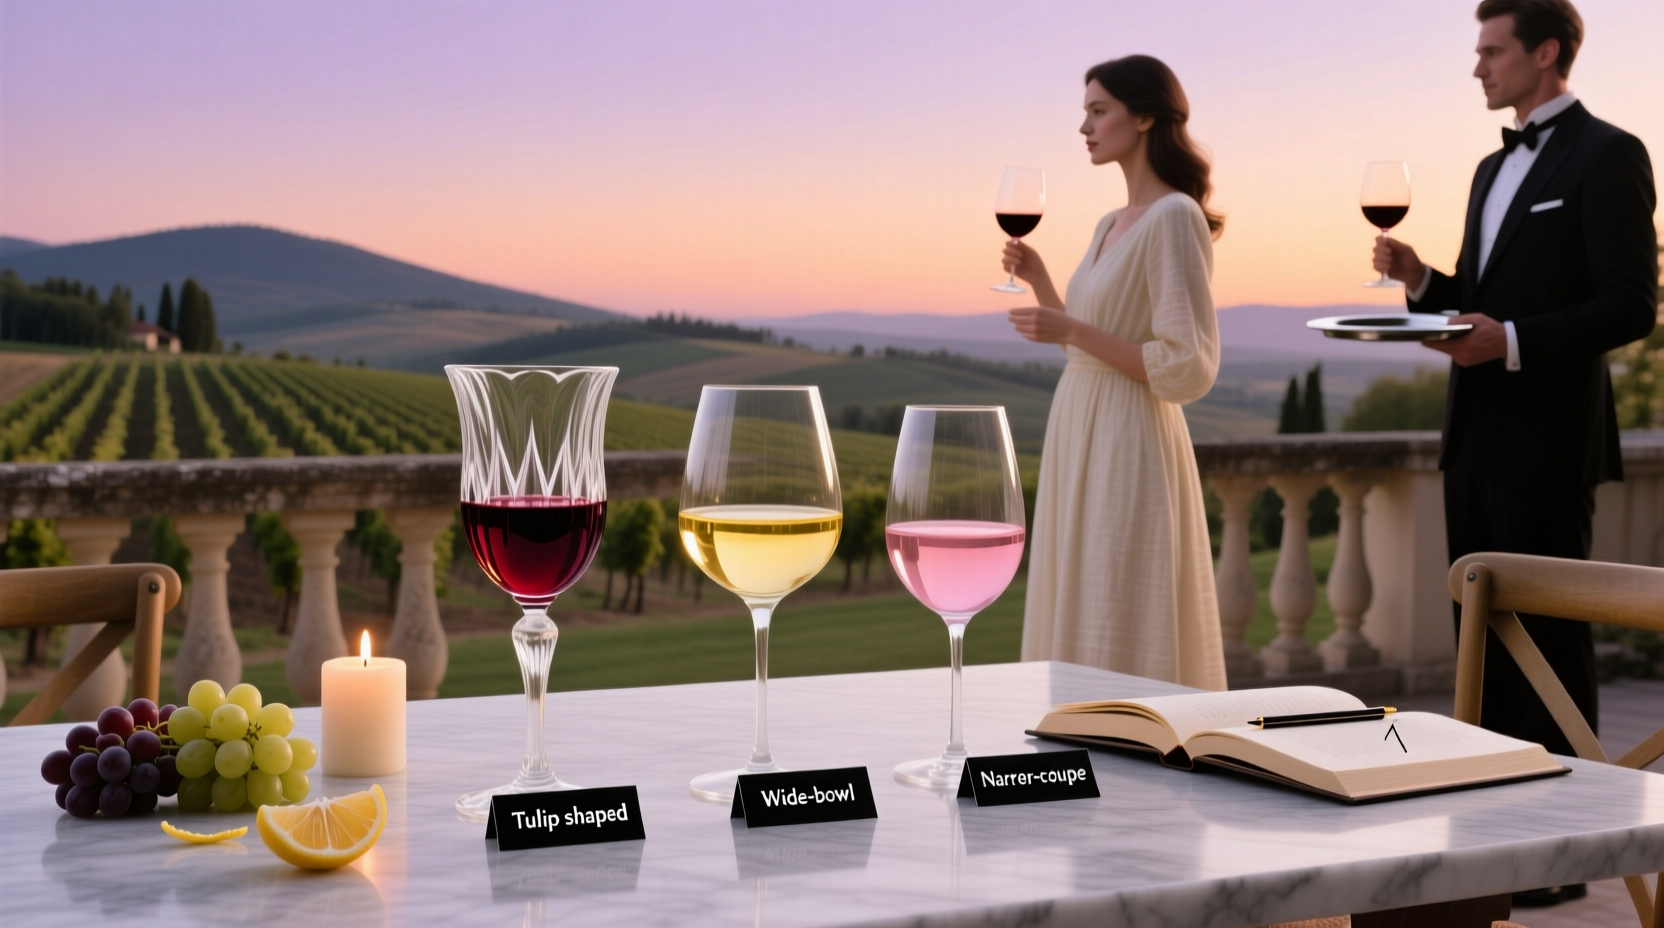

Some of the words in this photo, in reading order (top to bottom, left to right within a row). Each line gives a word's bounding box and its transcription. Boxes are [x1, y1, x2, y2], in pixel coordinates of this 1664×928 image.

[980, 767, 1087, 788] Narrer-coupe
[760, 782, 855, 808] Wide-bowl
[511, 808, 560, 833] Tulip
[564, 802, 629, 828] shaped
